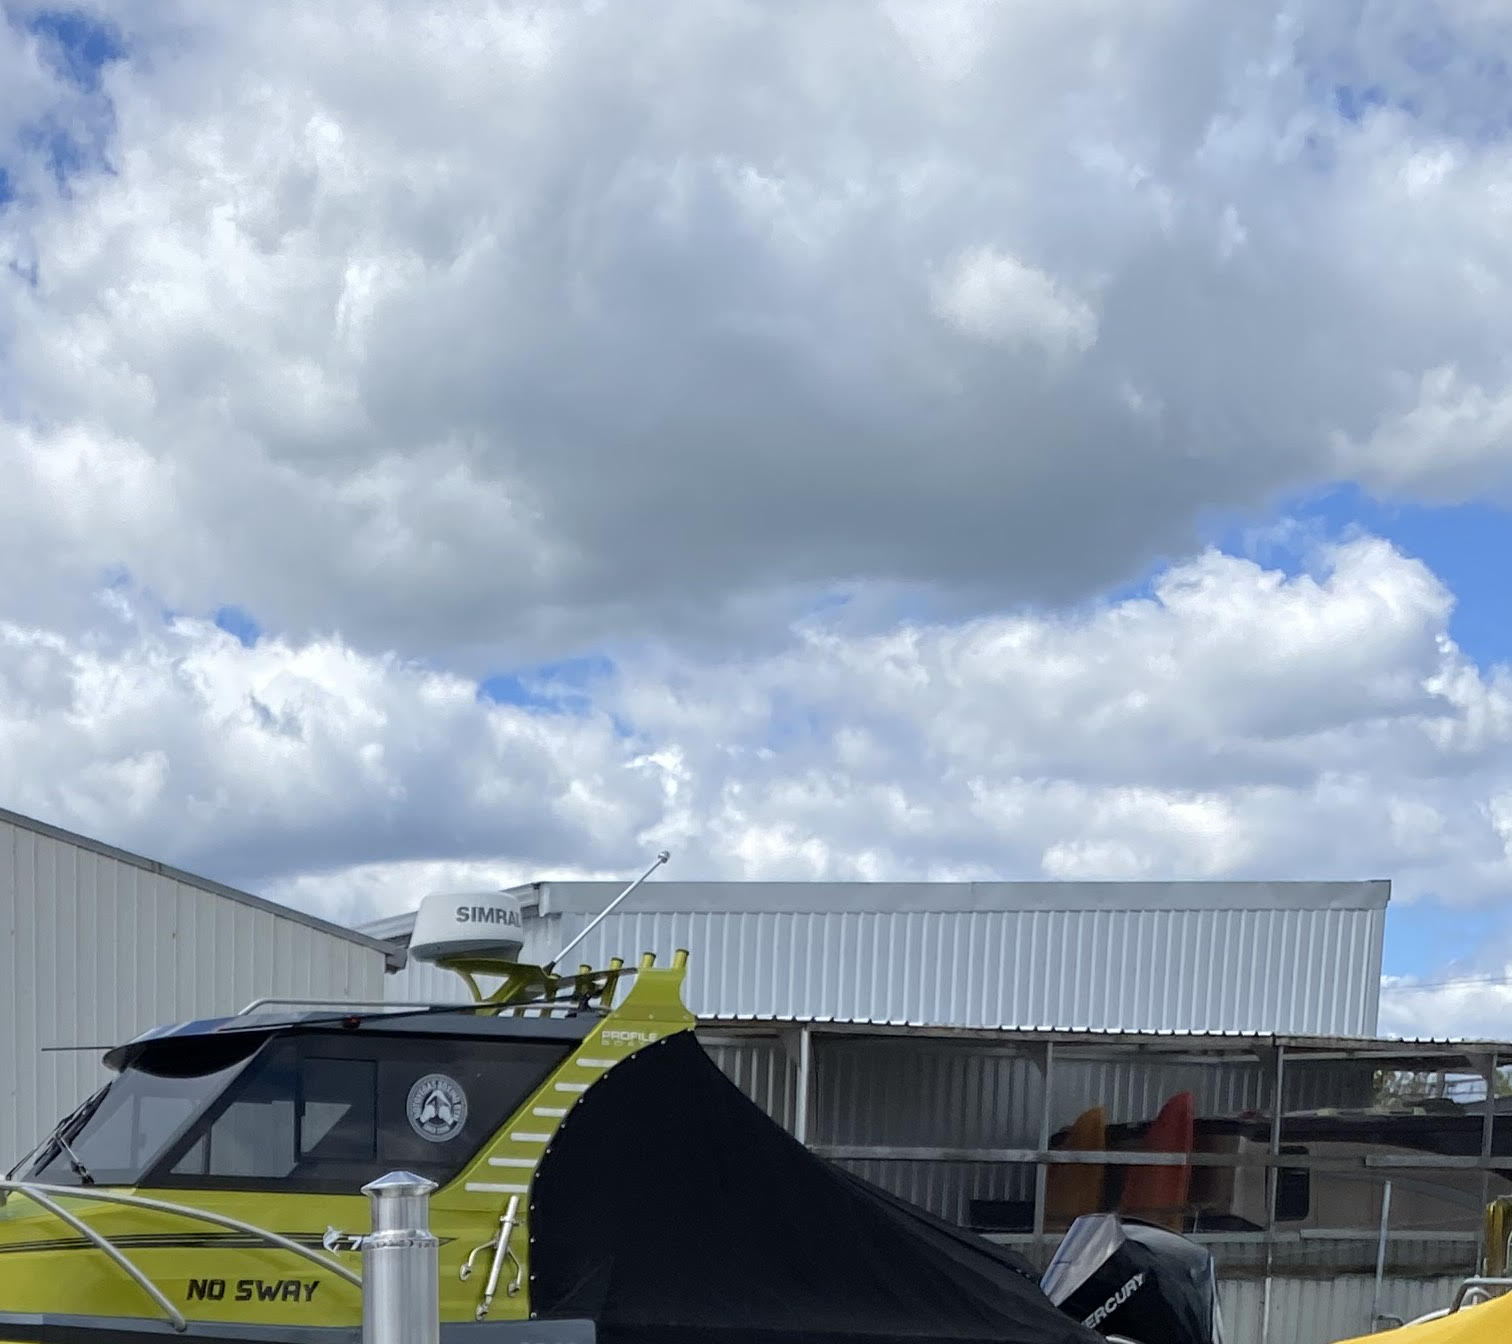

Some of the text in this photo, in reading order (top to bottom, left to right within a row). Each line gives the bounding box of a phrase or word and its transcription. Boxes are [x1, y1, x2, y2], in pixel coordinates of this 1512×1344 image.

[601, 1031, 658, 1042] PROFILE
[186, 1278, 321, 1302] NO SWAY
[1081, 1272, 1145, 1329] ERCURY
